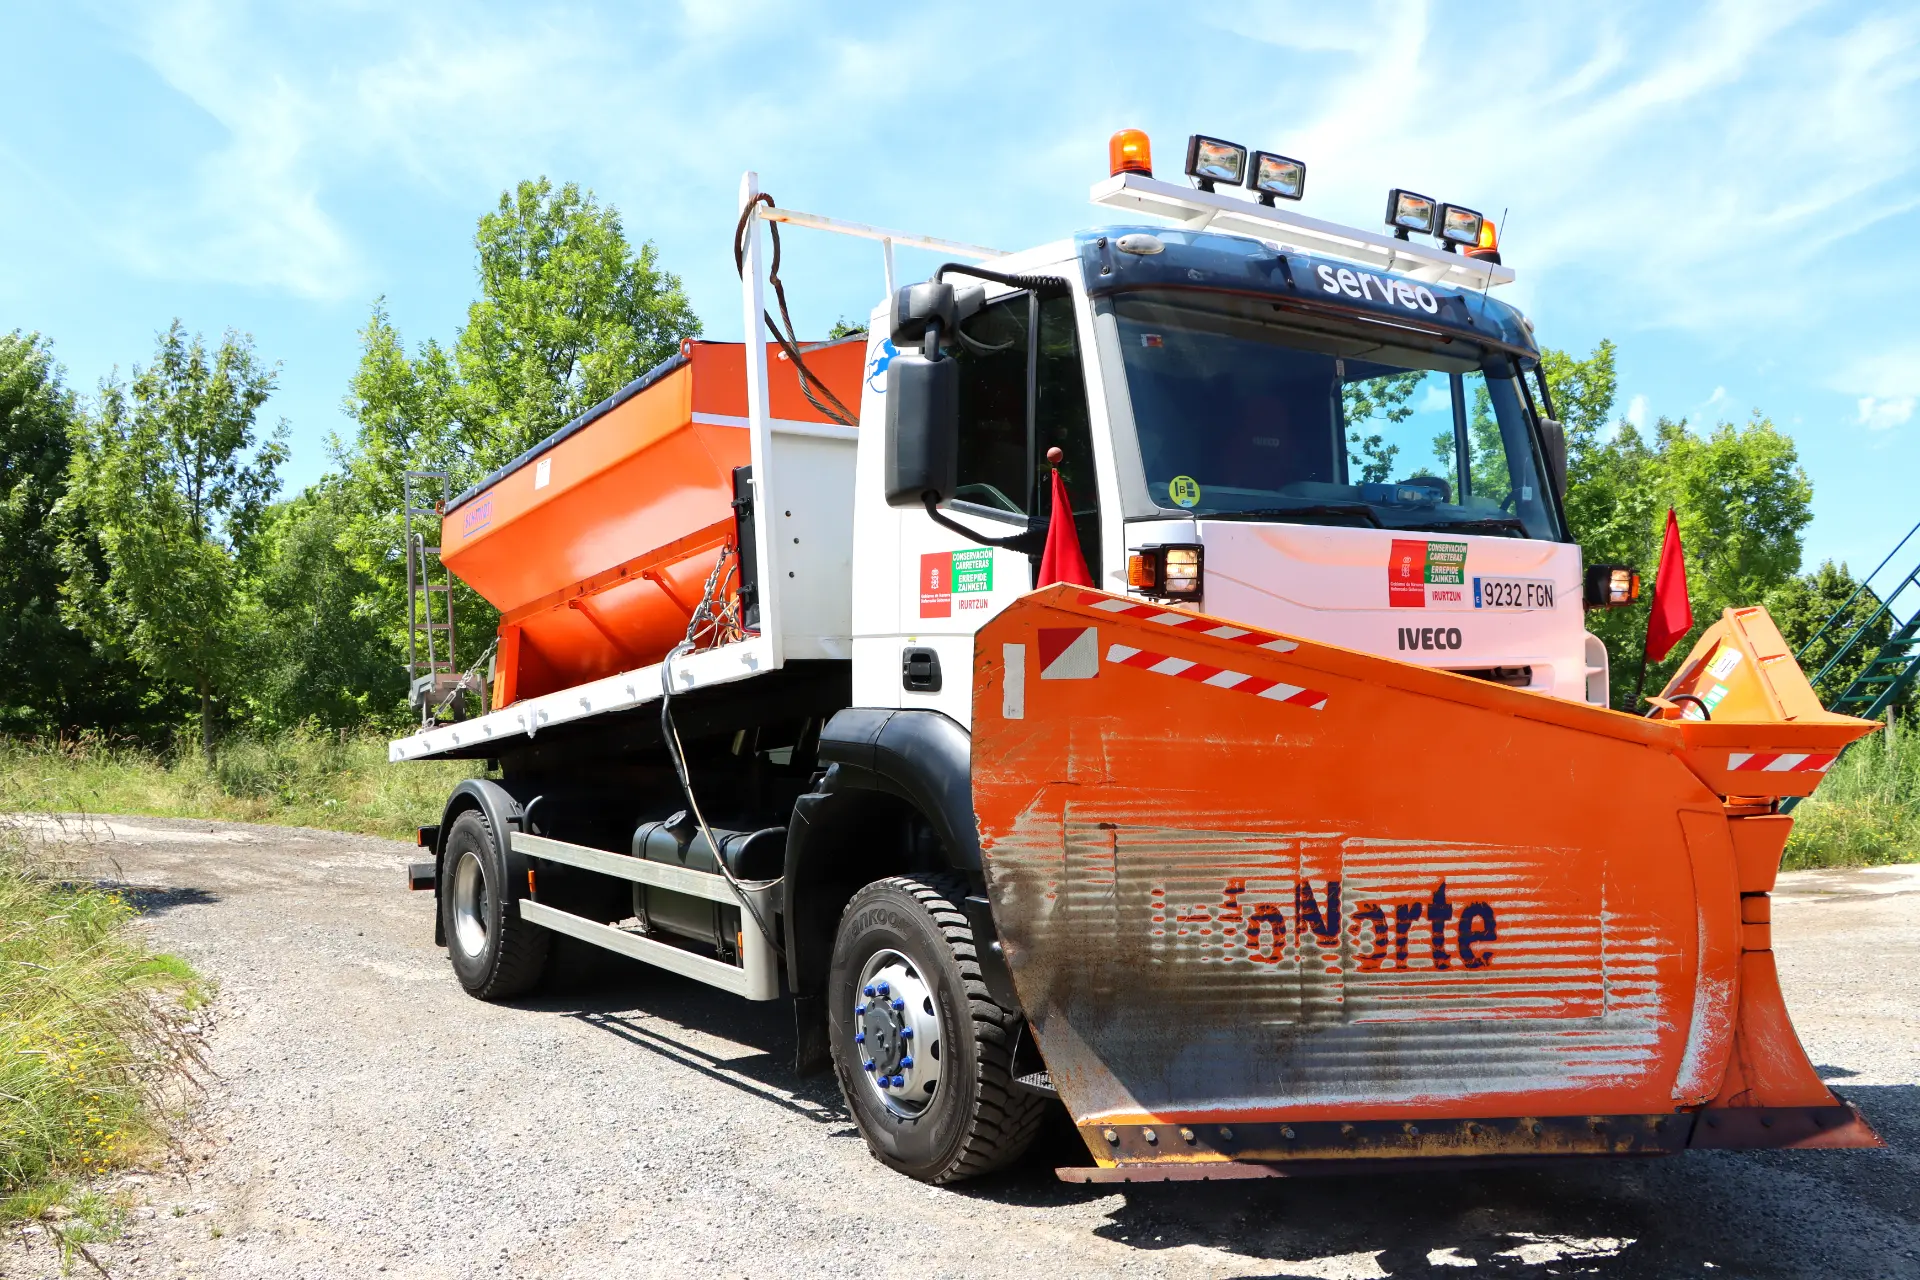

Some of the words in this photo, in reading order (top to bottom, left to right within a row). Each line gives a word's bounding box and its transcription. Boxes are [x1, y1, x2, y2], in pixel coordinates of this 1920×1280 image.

[1317, 264, 1438, 314] serveo
[1179, 485, 1186, 494] B
[1428, 543, 1467, 554] CONSERVACIÓN
[953, 549, 992, 560] CONSERVACIÓN
[1429, 553, 1463, 562] CARRETERAS
[956, 560, 989, 569] CARRETERAS
[1431, 565, 1459, 575] ERREPIDE
[959, 573, 987, 582] ERREPIDE
[1430, 574, 1459, 583] ZAINKETA
[958, 582, 987, 592] ZAINKETA
[1432, 591, 1461, 602] IRURTZUN
[1485, 582, 1522, 607] 9232
[1527, 584, 1554, 607] FGN
[959, 599, 988, 609] IRURTZUN
[1398, 627, 1462, 651] IVECO
